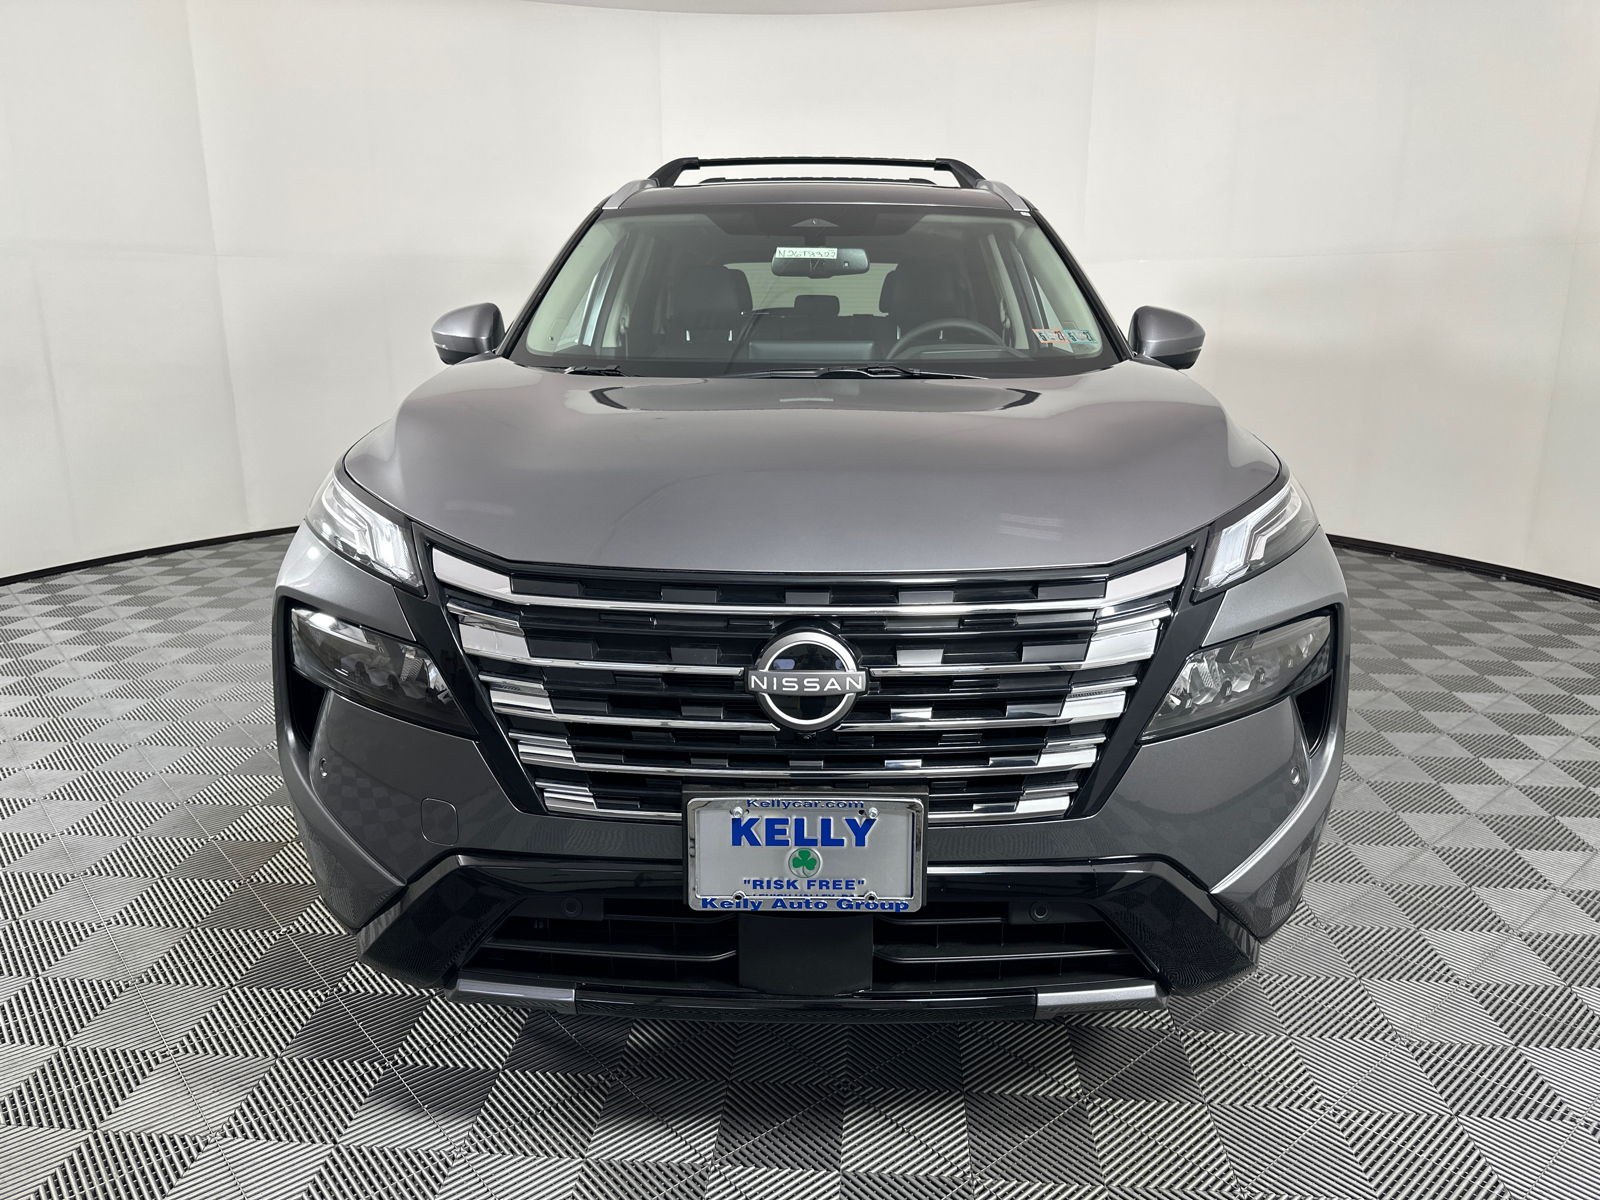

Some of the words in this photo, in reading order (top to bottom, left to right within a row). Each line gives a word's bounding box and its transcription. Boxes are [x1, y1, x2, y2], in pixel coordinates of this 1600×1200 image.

[751, 675, 862, 691] NISSAN
[747, 799, 864, 809] Kellycar.com
[731, 817, 877, 847] KELLY
[743, 879, 799, 890] "RISK
[807, 879, 865, 890] FREE"
[701, 897, 762, 912] Kelly
[771, 898, 828, 910] Auto
[836, 899, 910, 913] Group
